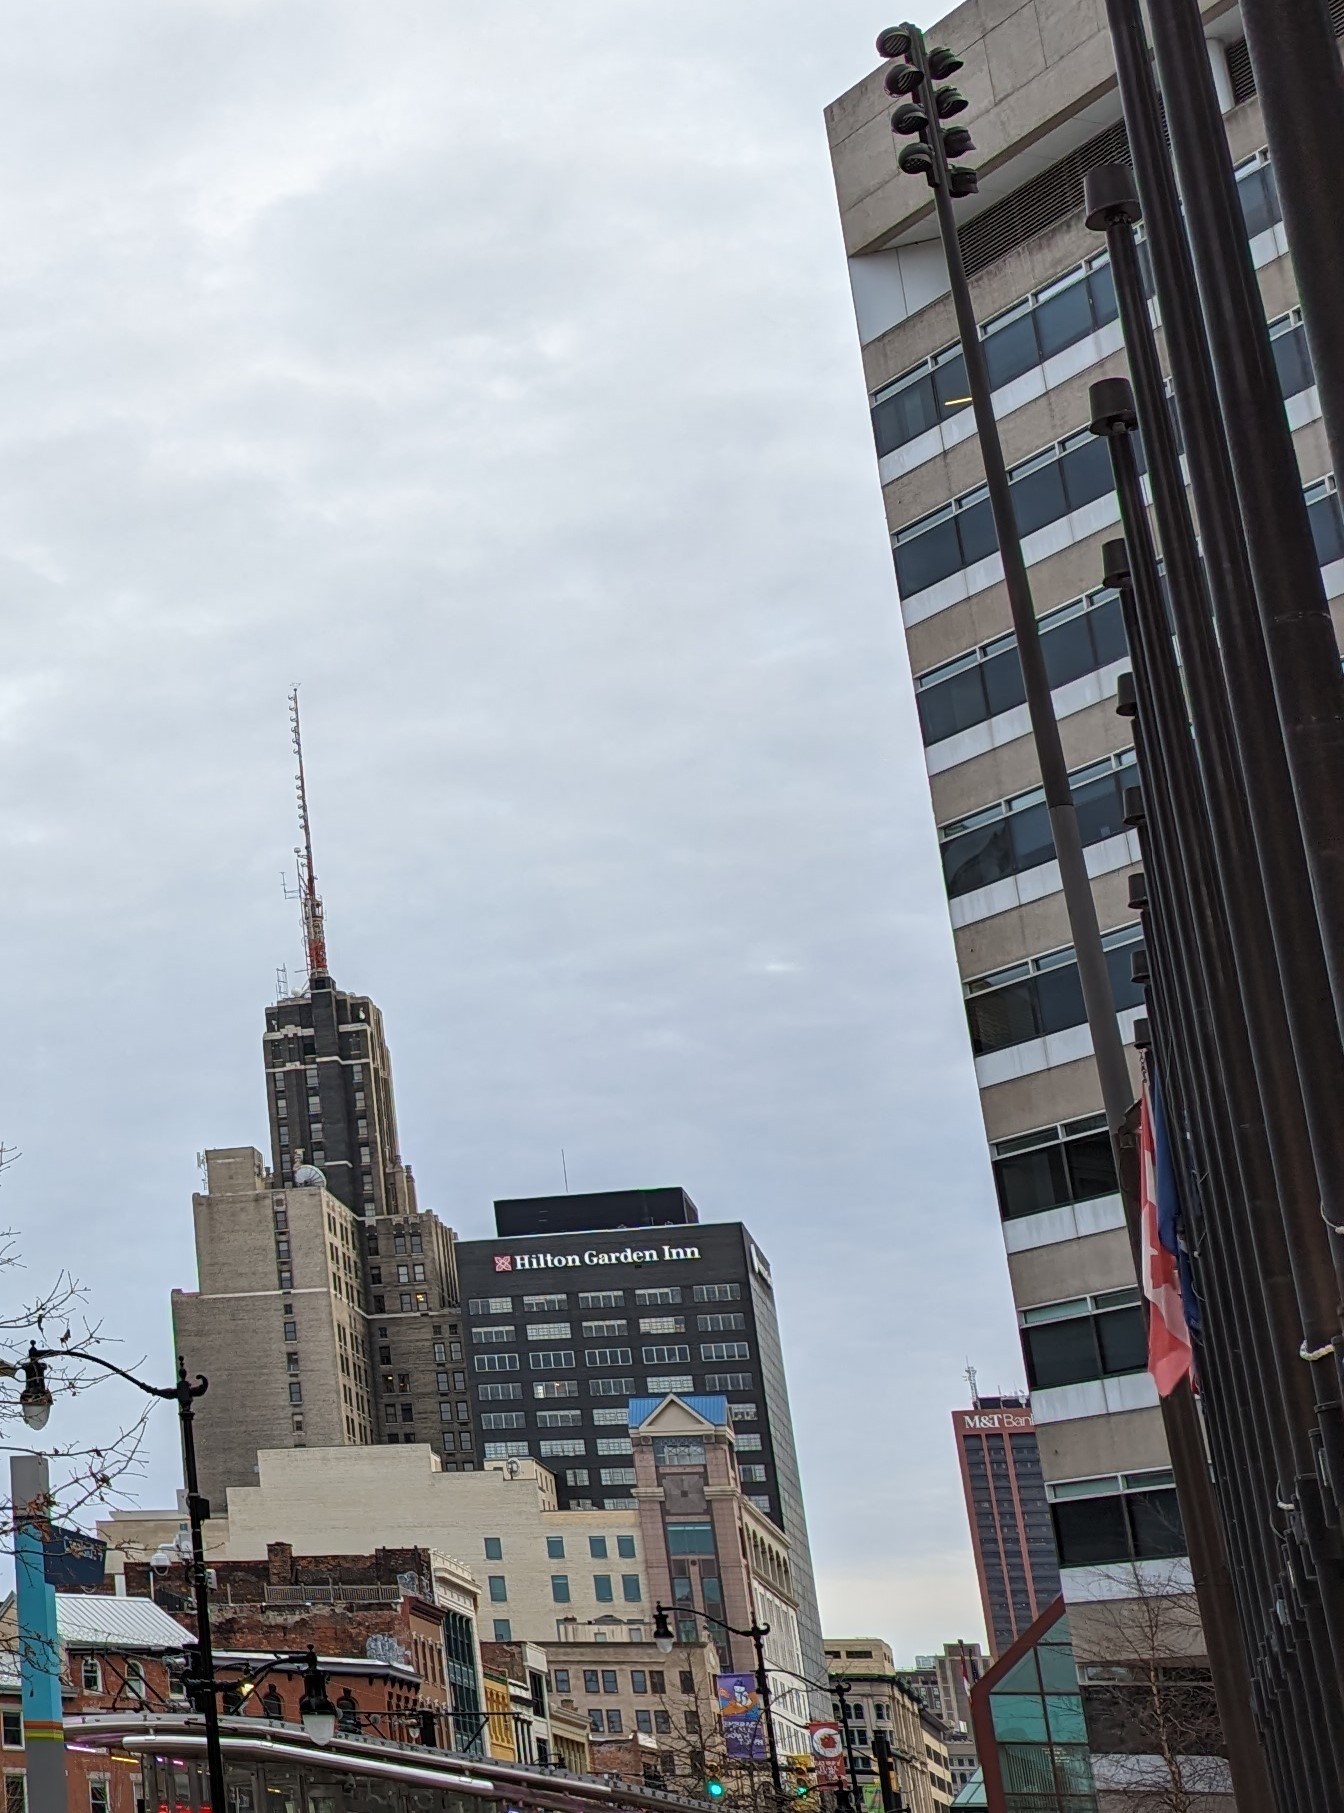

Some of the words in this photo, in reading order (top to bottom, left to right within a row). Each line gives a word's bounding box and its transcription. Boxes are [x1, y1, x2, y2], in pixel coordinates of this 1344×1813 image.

[514, 1254, 582, 1270] Hilton
[583, 1248, 660, 1266] Garden
[662, 1245, 701, 1261] Inn
[963, 1413, 1002, 1429] M&T
